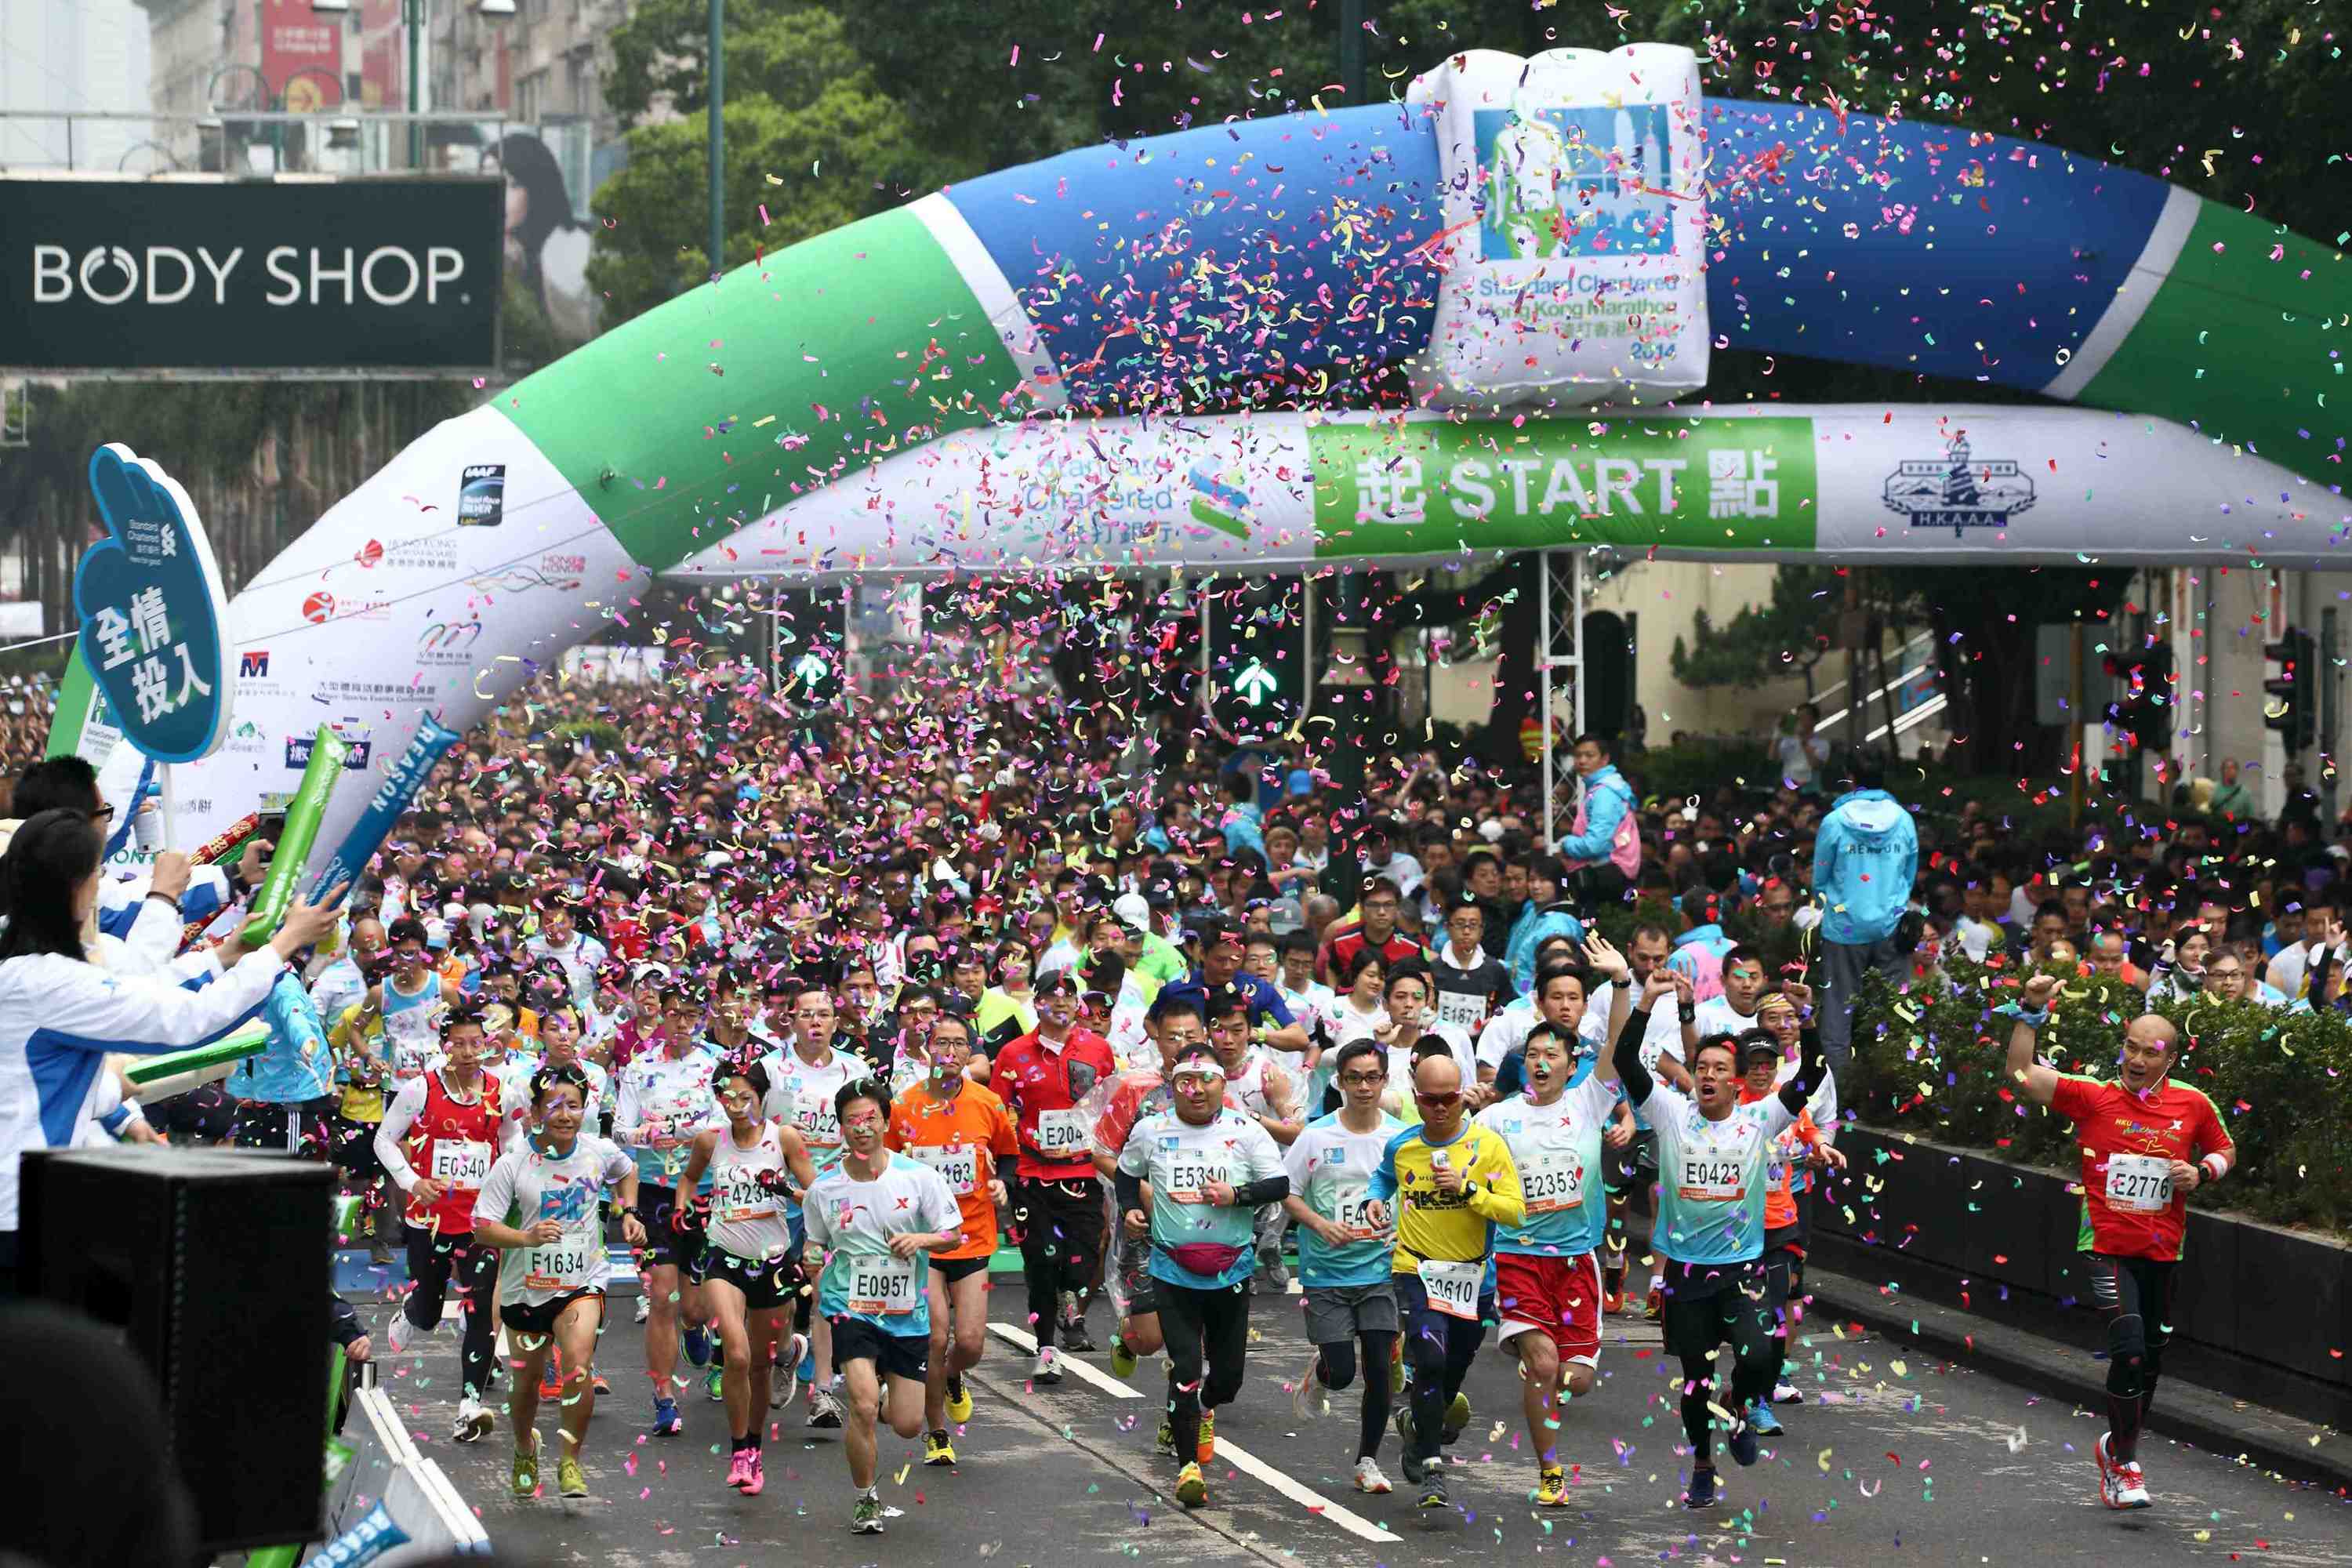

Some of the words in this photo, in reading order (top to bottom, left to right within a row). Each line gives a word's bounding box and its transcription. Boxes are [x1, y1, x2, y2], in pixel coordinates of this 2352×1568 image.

[34, 245, 243, 304] BODY
[1536, 301, 1581, 318] Kong
[1631, 342, 1675, 360] 2014
[1356, 457, 1426, 524] 起
[1450, 458, 1687, 517] START
[1708, 448, 1778, 518] 點
[96, 586, 171, 671] 全情
[132, 642, 212, 724] 投入
[372, 725, 436, 812] REASON
[1523, 1170, 1577, 1199] E2353
[1686, 1162, 1740, 1185] E0423
[2115, 1173, 2169, 1200] E2776
[857, 1274, 909, 1298] E0957
[1427, 1277, 1472, 1302] E0610
[300, 1510, 390, 1568] REASO
